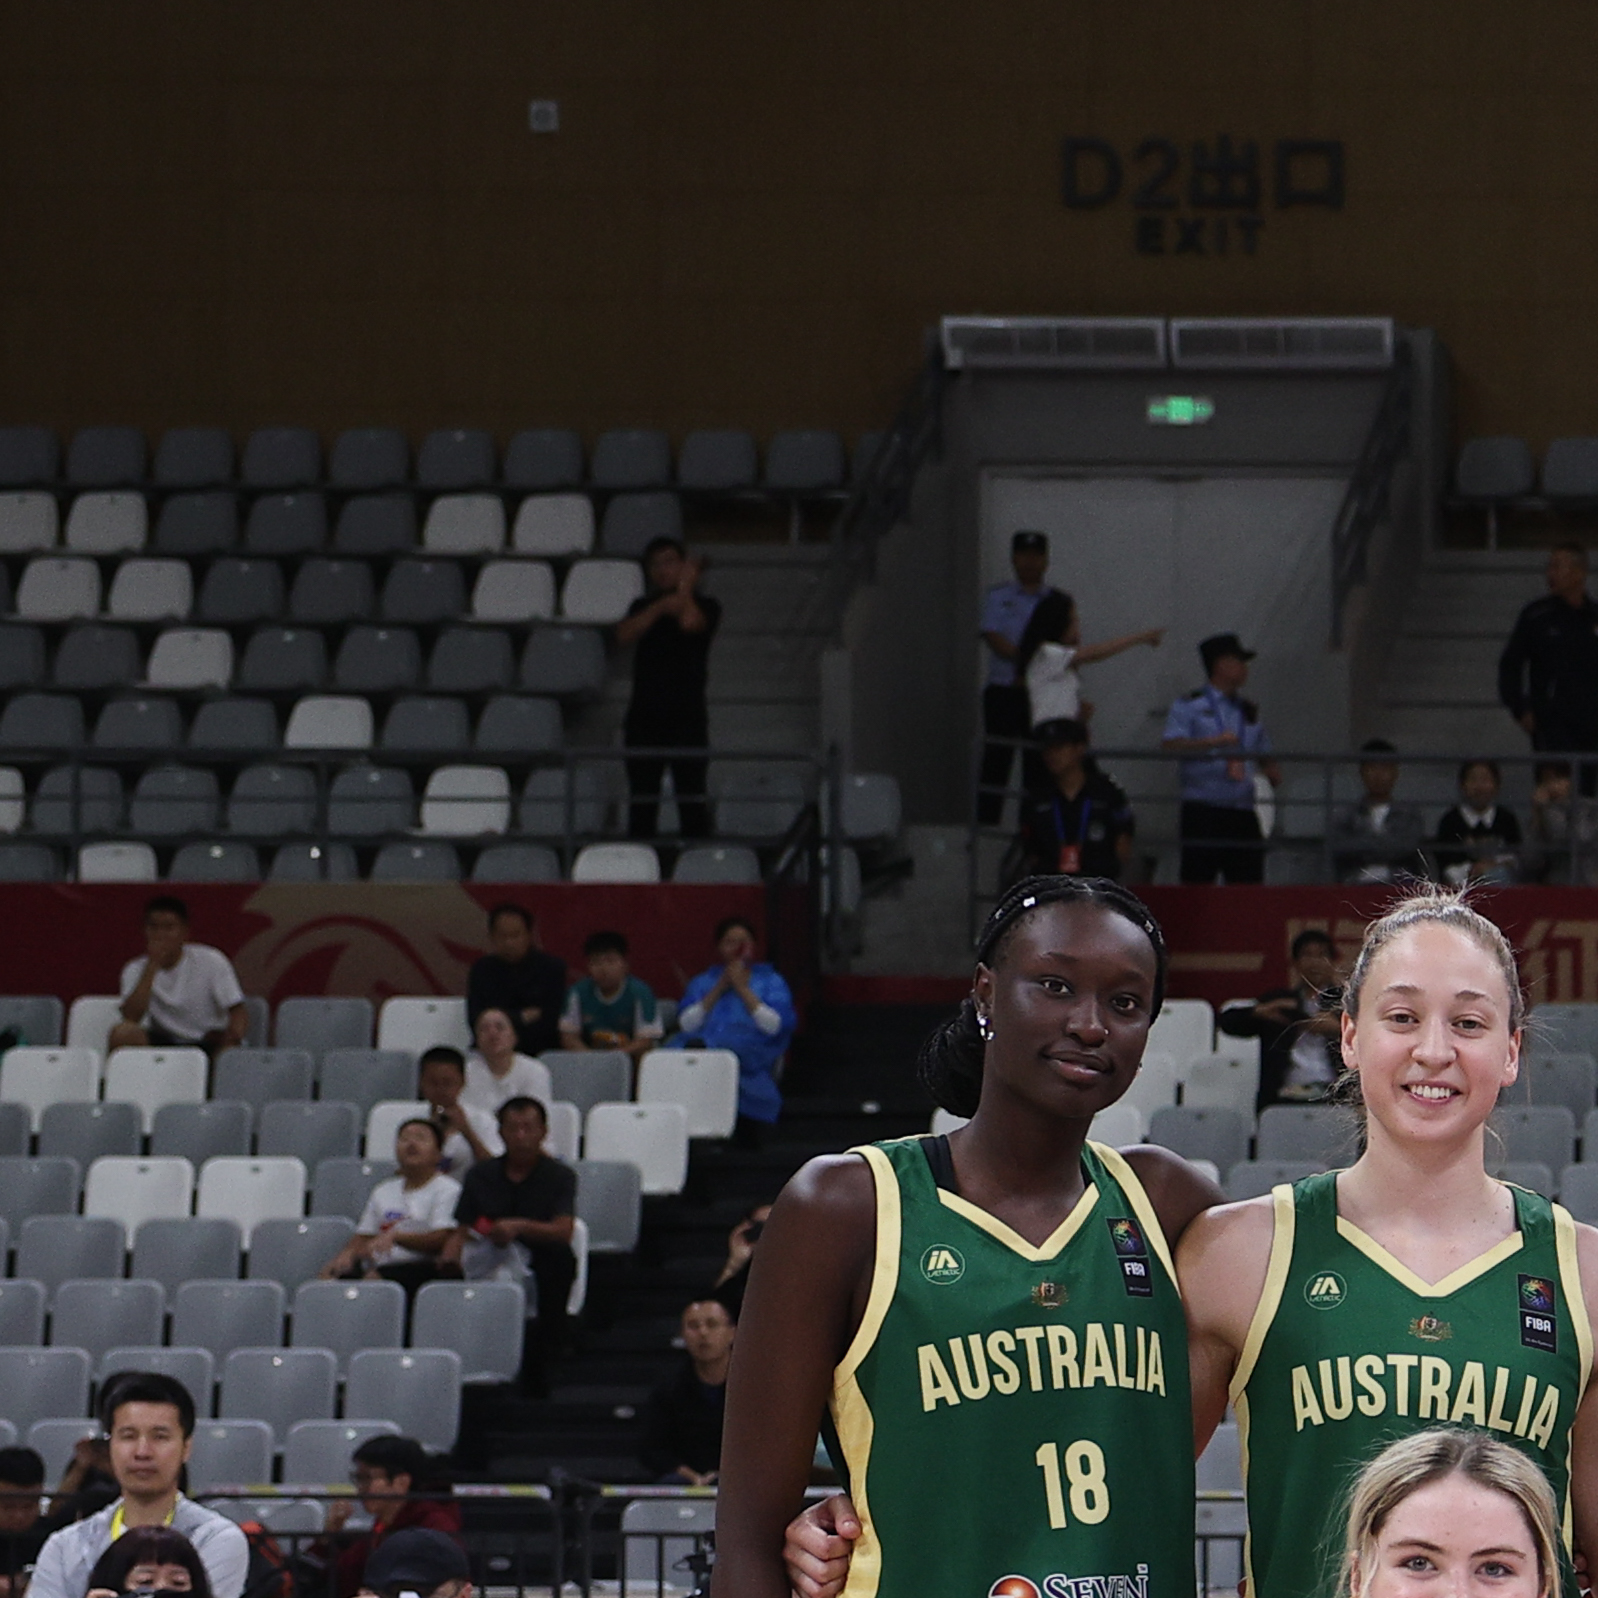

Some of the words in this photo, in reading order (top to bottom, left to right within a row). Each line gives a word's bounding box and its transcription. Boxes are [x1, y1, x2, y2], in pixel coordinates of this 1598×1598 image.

[1134, 215, 1265, 254] EXIT
[917, 1322, 1166, 1412] AUSTRALIA
[1524, 1316, 1552, 1333] FIBA
[1291, 1354, 1560, 1450] AUSTRALIA
[1035, 1440, 1110, 1529] 18
